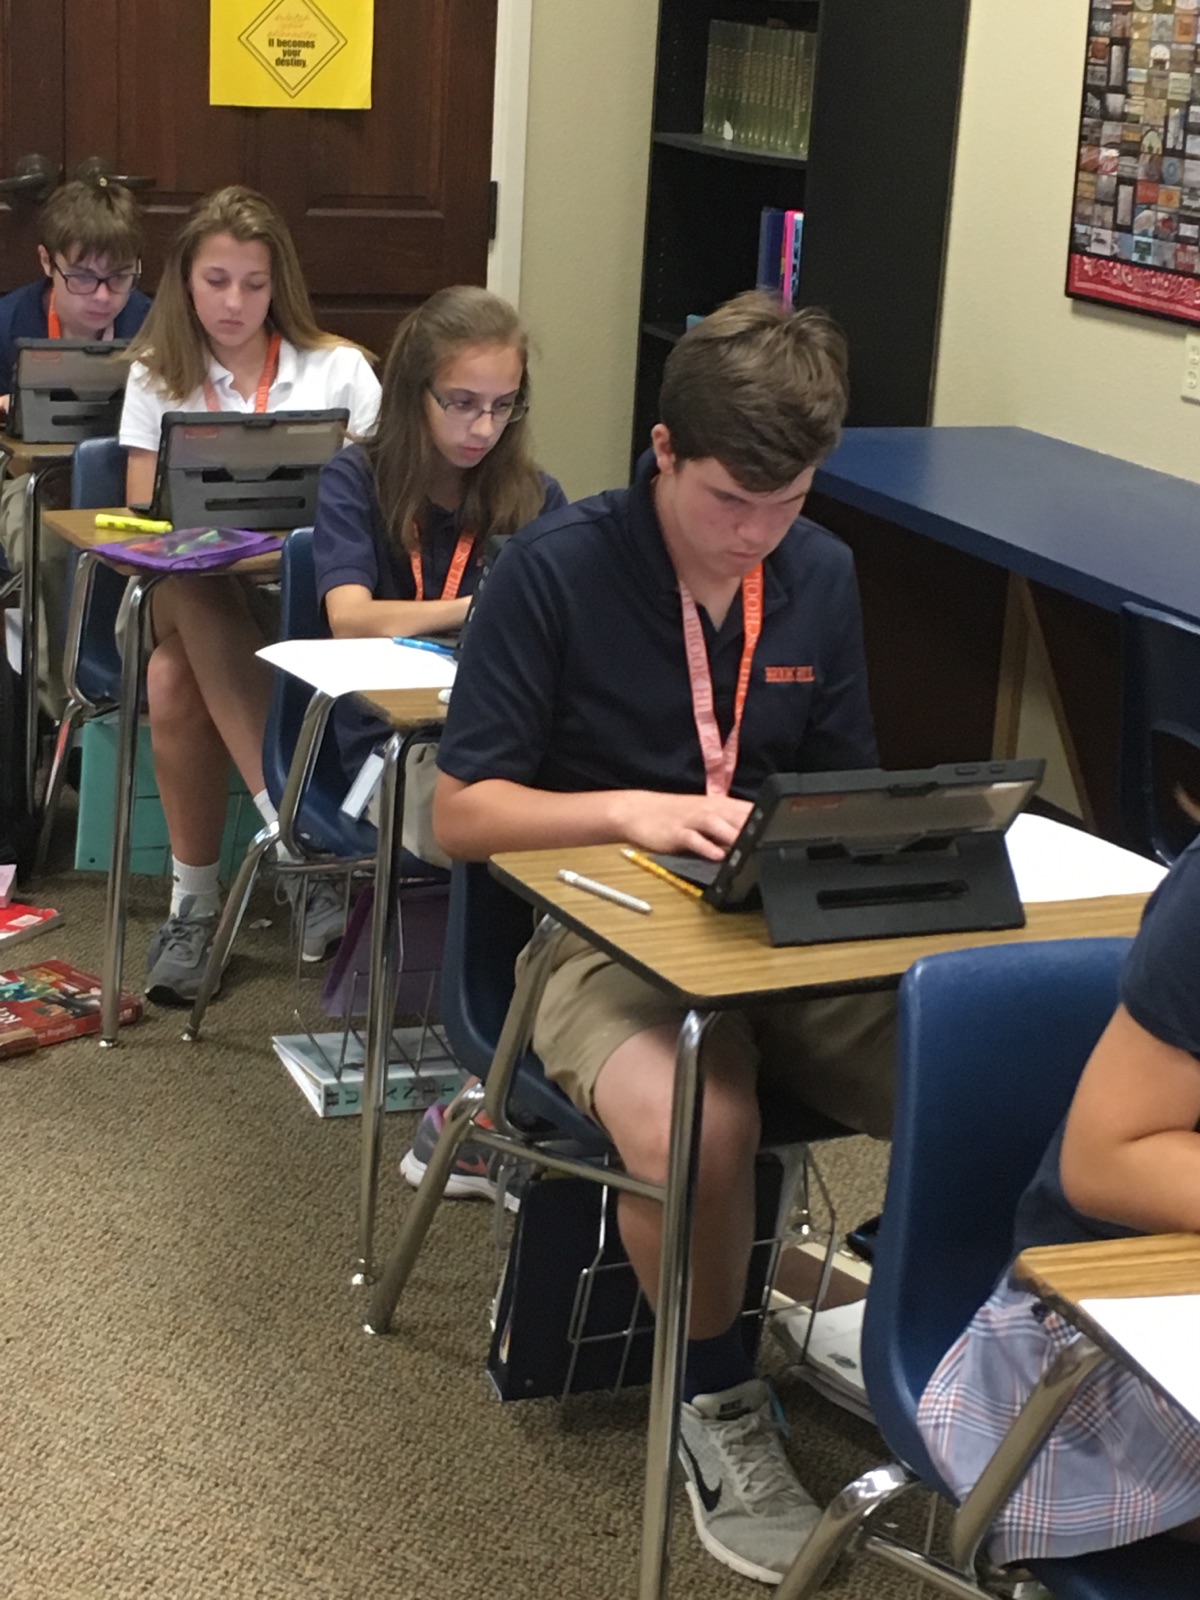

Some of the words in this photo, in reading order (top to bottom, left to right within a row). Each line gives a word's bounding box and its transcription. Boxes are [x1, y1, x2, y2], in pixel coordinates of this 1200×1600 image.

[276, 38, 315, 49] becomes
[282, 49, 302, 58] your
[745, 572, 761, 649] SCHOOL
[684, 616, 707, 683] BROOK
